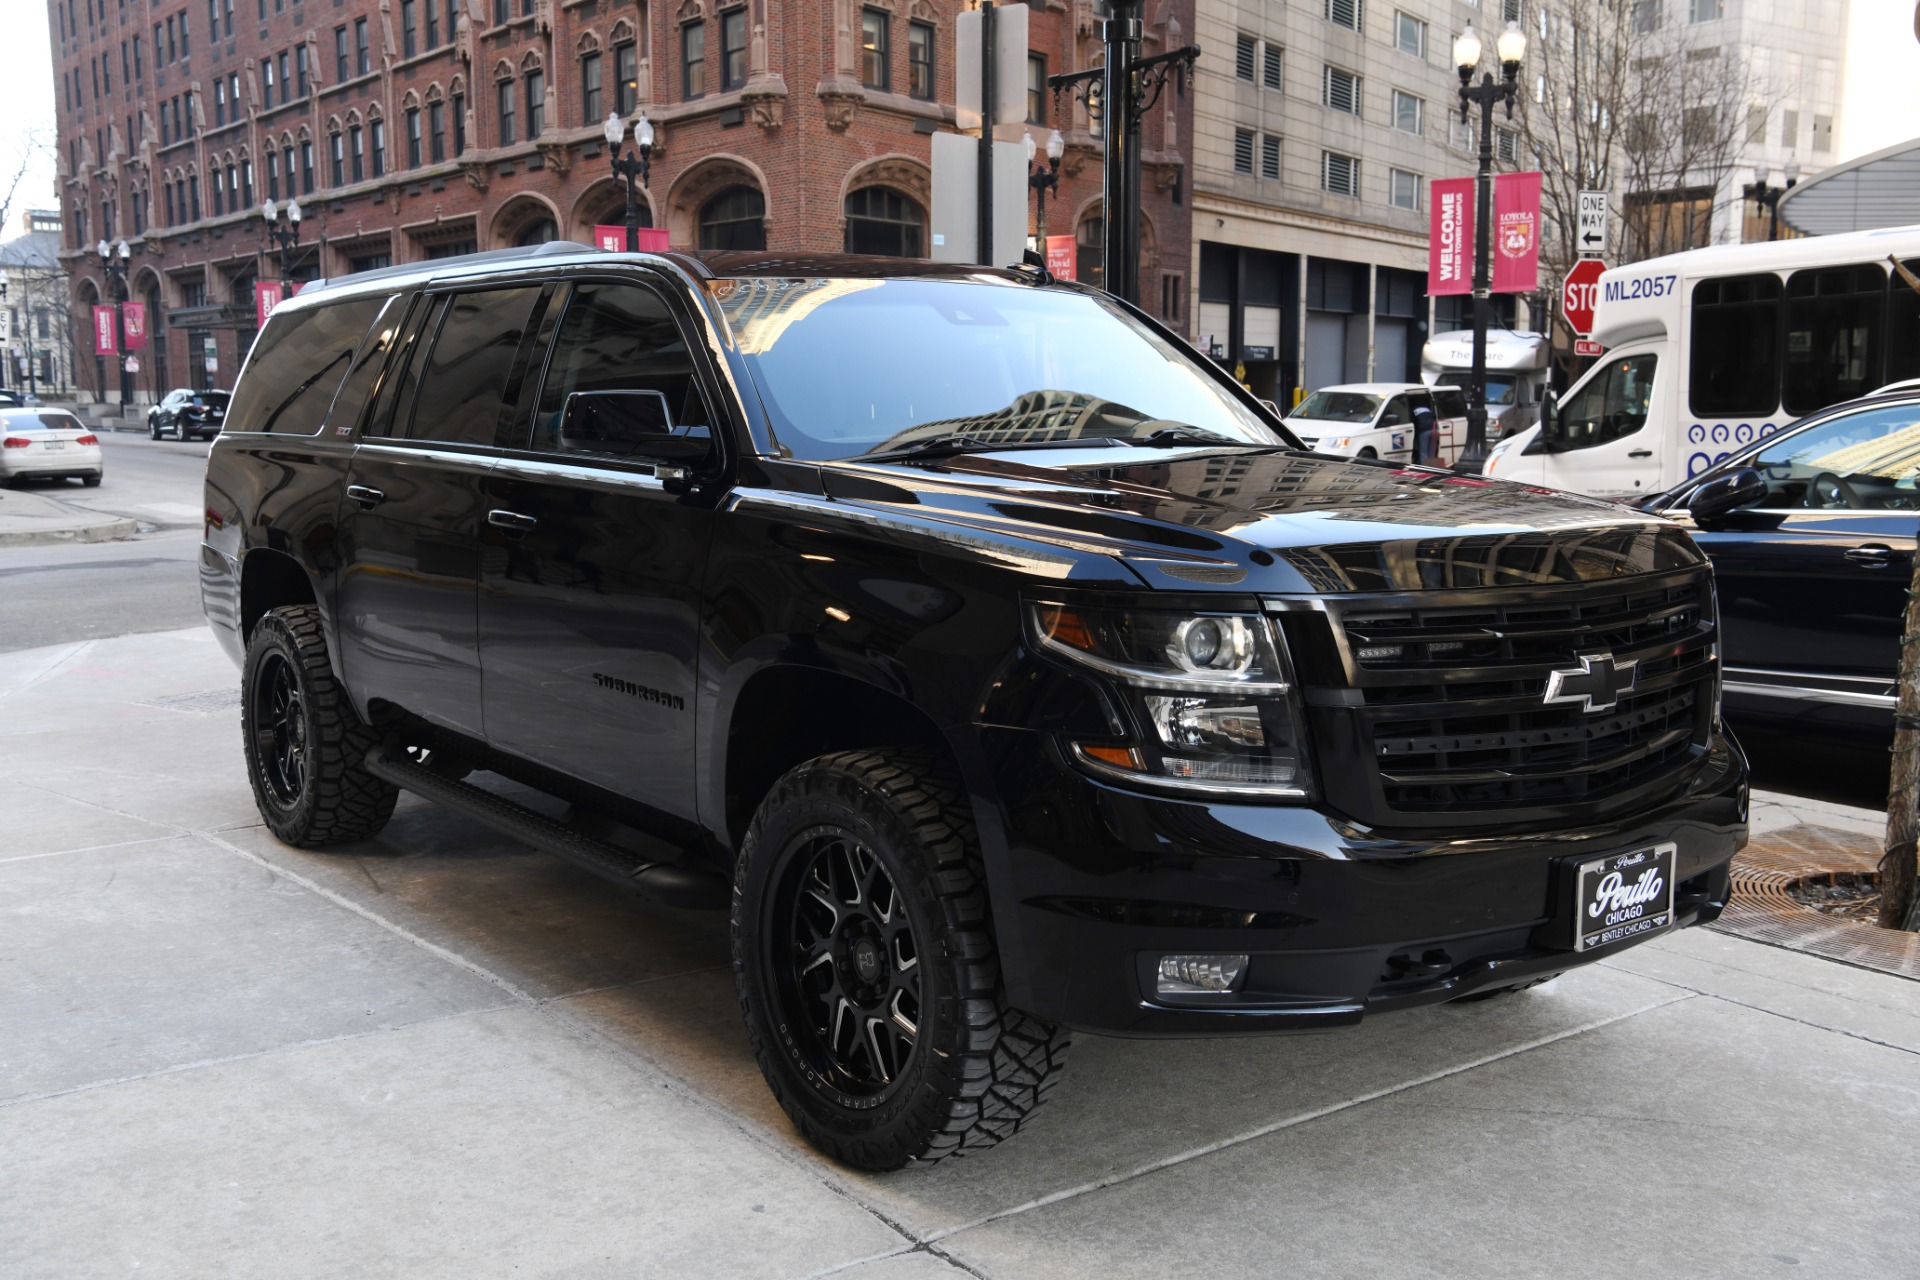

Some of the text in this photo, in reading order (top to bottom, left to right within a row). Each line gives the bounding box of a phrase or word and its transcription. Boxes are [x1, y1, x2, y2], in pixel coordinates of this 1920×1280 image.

[1500, 212, 1534, 220] LOYOLA
[1582, 197, 1604, 211] ONE
[1581, 214, 1604, 228] WAY
[1440, 193, 1454, 281] WELCOME
[1567, 283, 1598, 311] STO
[1605, 275, 1677, 302] ML2057
[262, 290, 271, 317] COME
[1450, 351, 1470, 359] The
[592, 672, 684, 711] SUBURBAN
[1588, 867, 1663, 918] Perillo
[1605, 904, 1643, 926] CHICAGO
[1602, 919, 1651, 942] BENTLEY CHICAGO
